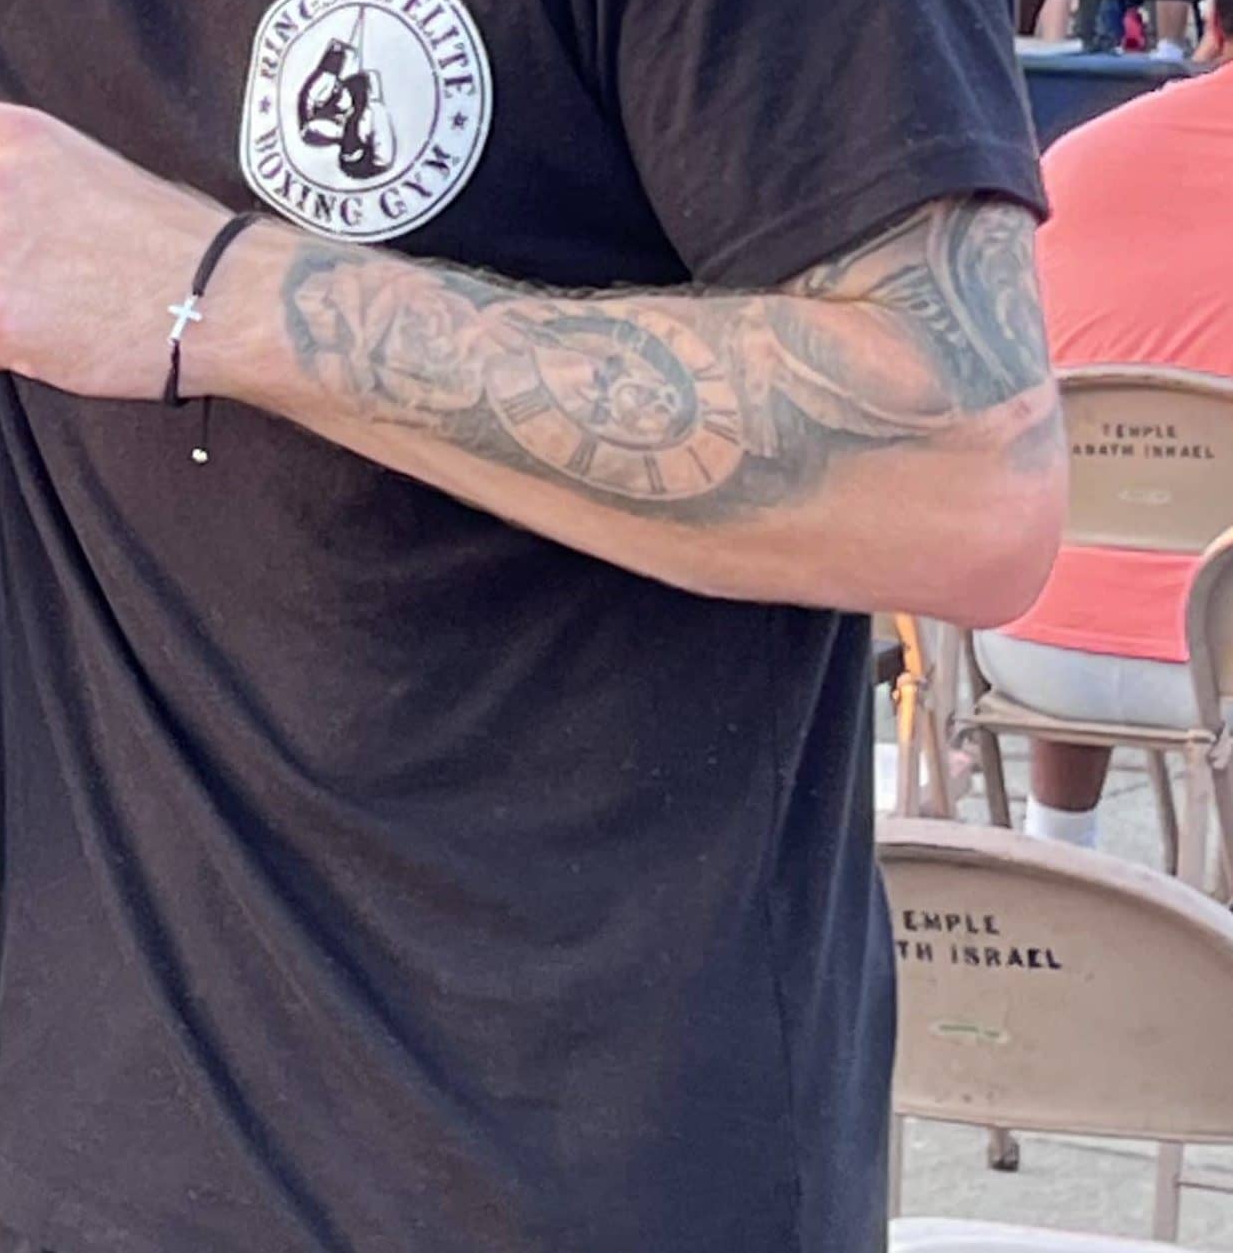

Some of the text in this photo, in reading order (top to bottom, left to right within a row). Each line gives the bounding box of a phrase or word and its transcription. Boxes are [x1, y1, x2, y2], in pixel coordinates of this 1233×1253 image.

[255, 128, 461, 227] BOXING GYM
[1101, 423, 1178, 439] TEMPLE
[902, 910, 1001, 935] EMPLE
[951, 944, 1063, 970] ISRAEL
